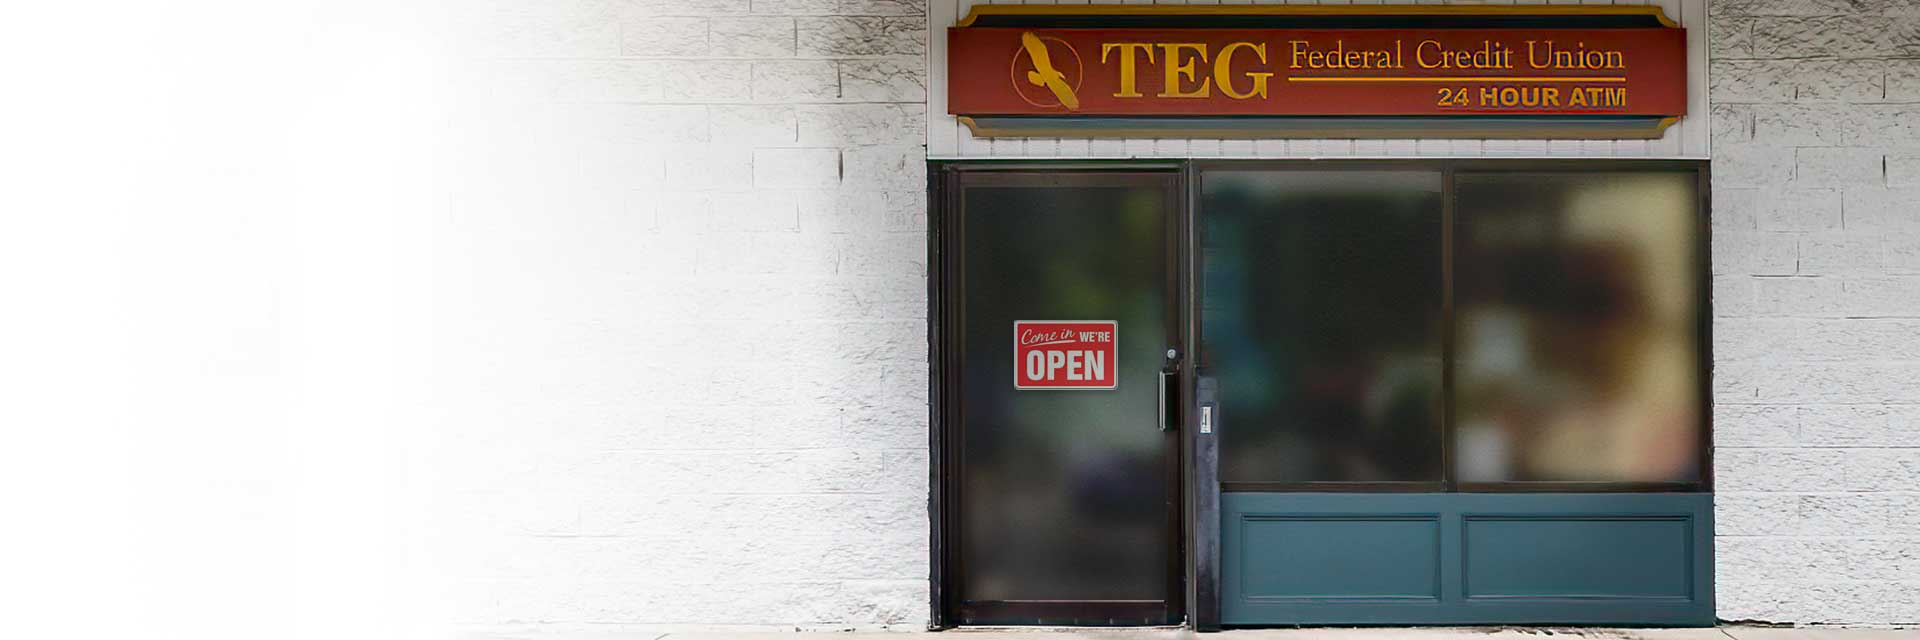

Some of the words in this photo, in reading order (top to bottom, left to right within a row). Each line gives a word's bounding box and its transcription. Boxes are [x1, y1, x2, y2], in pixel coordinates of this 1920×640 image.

[1101, 42, 1274, 99] TEG
[1288, 39, 1404, 69] Federal
[1416, 39, 1514, 69] Credit
[1525, 40, 1625, 69] Union
[1438, 87, 1470, 107] 24
[1480, 87, 1560, 107] HOUR
[1568, 87, 1627, 107] ATM
[1021, 329, 1057, 345] Come
[1060, 328, 1076, 339] in
[1079, 331, 1111, 342] WE'RE
[1026, 349, 1105, 381] OPEN
